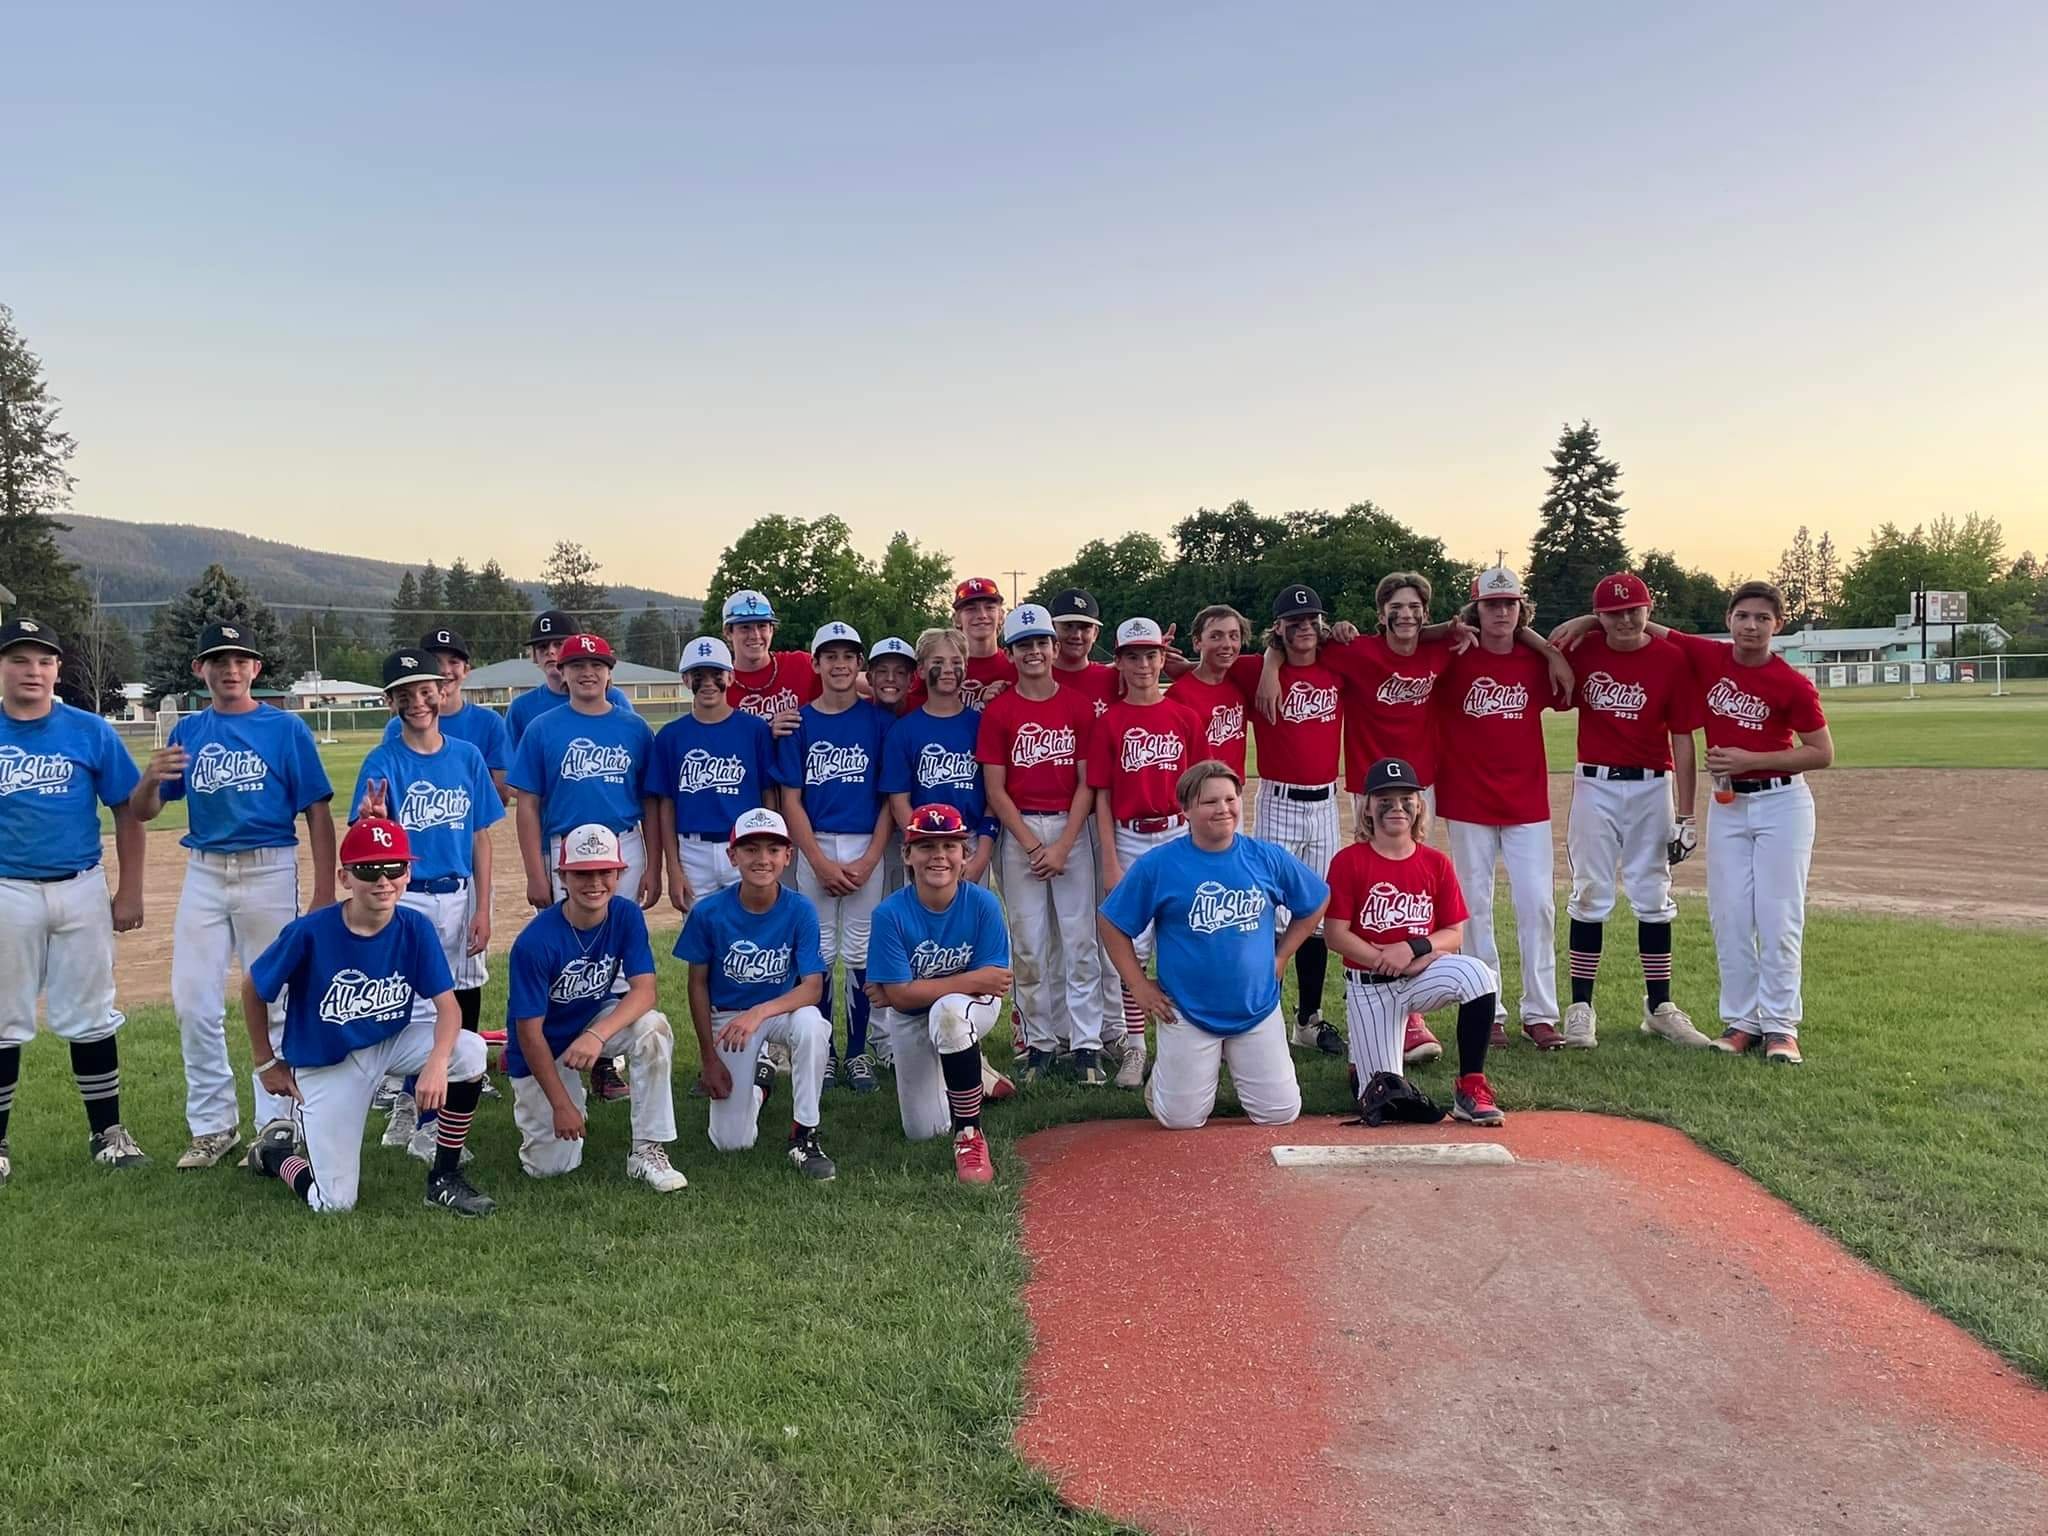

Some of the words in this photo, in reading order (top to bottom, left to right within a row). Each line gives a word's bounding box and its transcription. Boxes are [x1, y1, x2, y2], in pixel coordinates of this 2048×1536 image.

[1295, 591, 1308, 604] G
[1613, 583, 1629, 599] RC
[540, 617, 551, 632] G
[437, 630, 450, 643] G
[580, 637, 596, 653] RC
[1386, 763, 1402, 776] G
[237, 782, 265, 792] 2022
[716, 786, 740, 795] 2022
[371, 827, 393, 848] RC
[320, 980, 411, 1015] All-Stars
[375, 1010, 406, 1022] 2022
